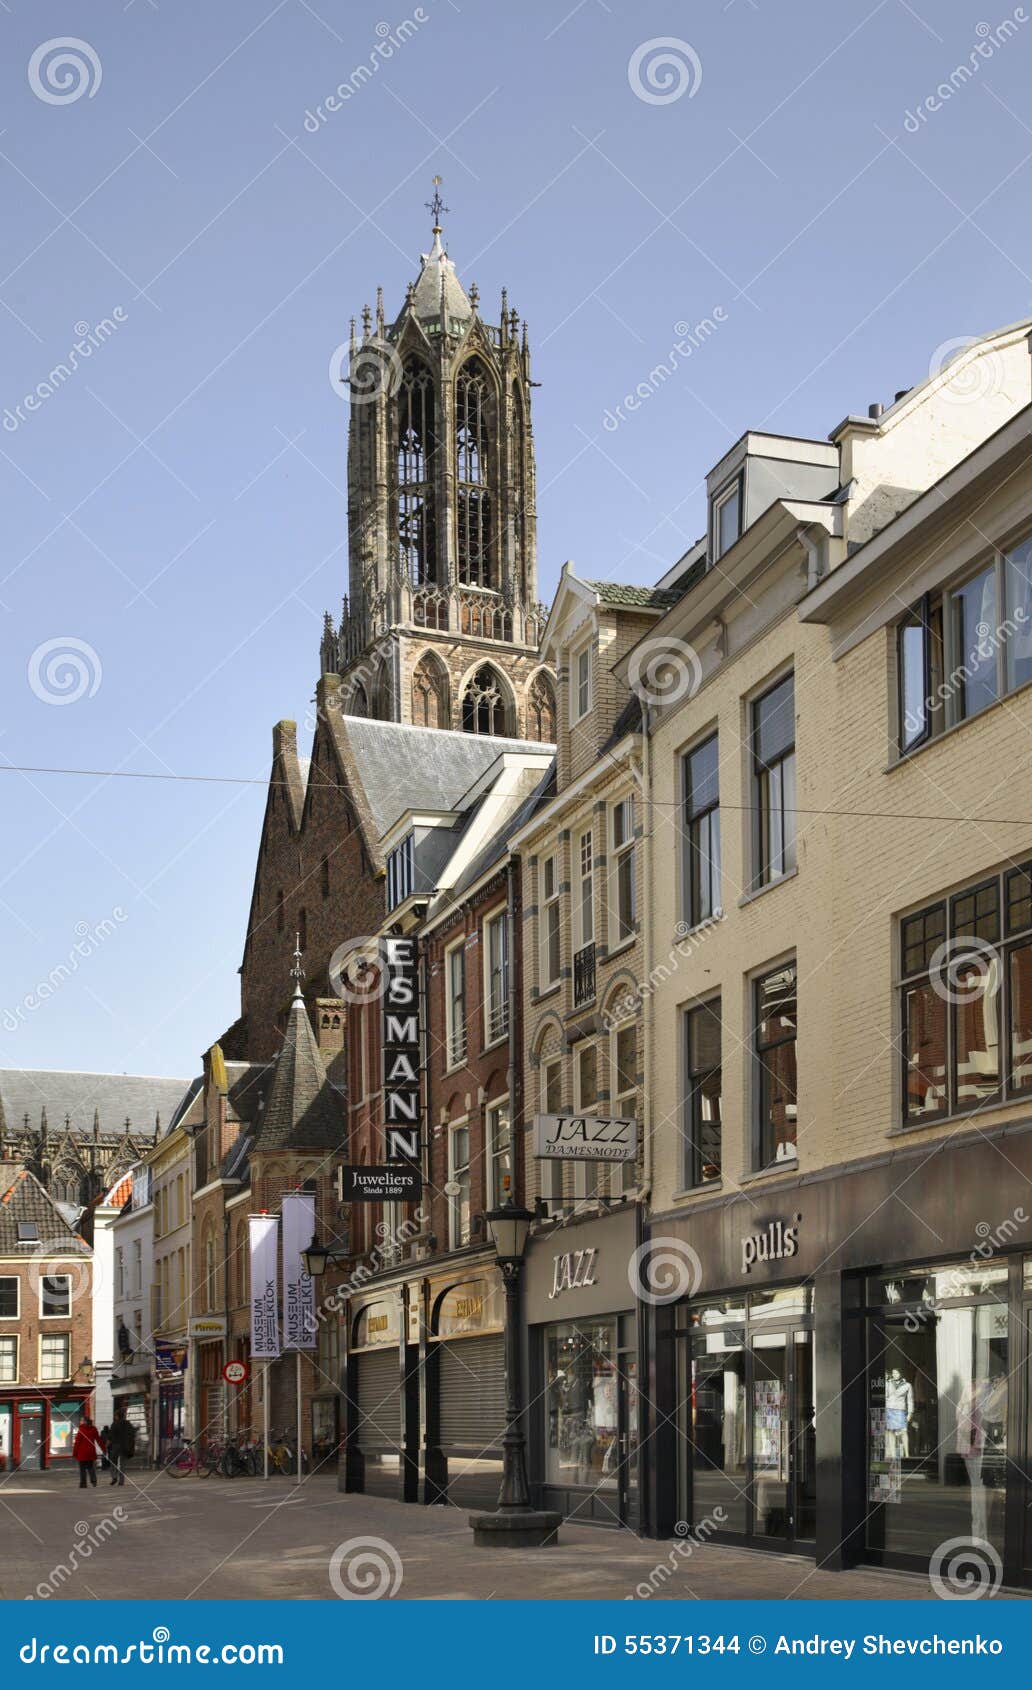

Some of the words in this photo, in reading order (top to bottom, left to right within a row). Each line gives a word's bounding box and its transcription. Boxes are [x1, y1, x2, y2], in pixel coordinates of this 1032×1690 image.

[386, 938, 418, 1158] ESMANN
[546, 1118, 631, 1144] JAZZ
[545, 1145, 631, 1158] DAMESMODE
[352, 1172, 414, 1187] Juweliers
[363, 1186, 383, 1194] Sinds
[385, 1186, 403, 1194] 1889
[548, 1248, 598, 1299] JAZZ
[254, 1299, 264, 1352] MUSEUM
[288, 1284, 298, 1343] MUSEUM
